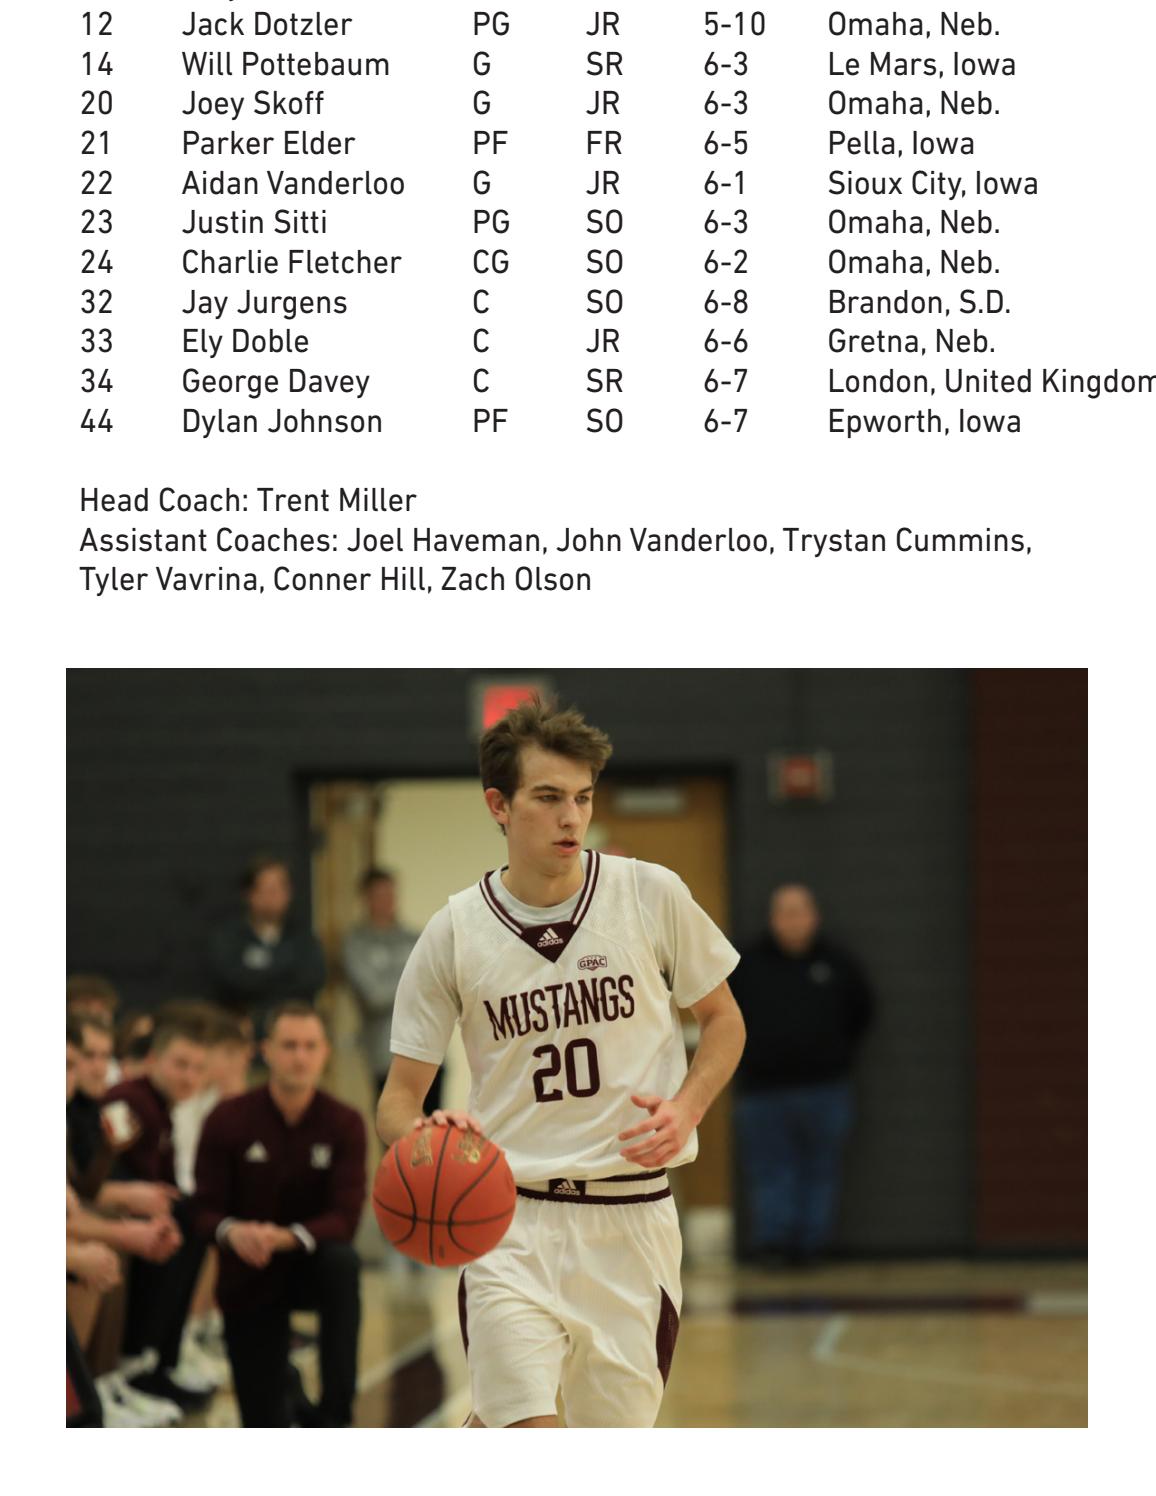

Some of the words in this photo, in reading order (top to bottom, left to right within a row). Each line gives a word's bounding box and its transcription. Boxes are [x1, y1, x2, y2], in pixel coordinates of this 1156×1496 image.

[82, 51, 114, 76] 14
[181, 51, 233, 76] Will
[242, 51, 389, 76] Pottebaum
[473, 51, 491, 76] G
[586, 51, 623, 76] SR
[704, 50, 748, 76] 6-3
[829, 51, 860, 76] Le
[870, 51, 944, 79] Mars,
[954, 51, 1016, 76] Iowa
[81, 129, 108, 155] 21
[183, 130, 275, 155] Parker
[284, 130, 356, 155] Elder
[474, 130, 508, 155] PF
[587, 130, 622, 155] FR
[704, 130, 748, 155] 6-5
[829, 130, 903, 158] Pella,
[913, 130, 974, 155] Iowa
[81, 169, 113, 195] 22
[181, 170, 258, 195] Aidan
[266, 170, 405, 195] Vanderloo
[473, 169, 491, 195] G
[585, 170, 620, 195] JR
[704, 170, 744, 195] 6-1
[828, 169, 903, 195] Sioux
[911, 169, 966, 201] City,
[976, 170, 1038, 195] Iowa
[81, 248, 114, 274] 24
[182, 248, 279, 274] Charlie
[289, 249, 402, 274] Fletcher
[473, 248, 509, 274] CG
[586, 248, 623, 274] SO
[704, 248, 748, 274] 6-2
[828, 248, 931, 277] Omaha,
[941, 249, 1000, 274] Neb.
[80, 327, 113, 353] 33
[183, 328, 223, 359] Ely
[232, 328, 309, 353] Doble
[473, 327, 490, 353] C
[585, 328, 620, 353] JR
[704, 328, 748, 353] 6-6
[828, 327, 926, 356] Gretna,
[936, 328, 995, 353] Neb.
[80, 368, 114, 393] 34
[182, 367, 279, 400] George
[289, 368, 370, 399] Davey
[473, 367, 490, 393] C
[586, 367, 623, 393] SR
[704, 368, 748, 393] 6-7
[829, 368, 936, 396] London,
[945, 368, 1032, 393] United
[80, 408, 114, 433] 44
[183, 408, 258, 439] Dylan
[267, 408, 382, 433] Johnson
[474, 408, 508, 433] PF
[586, 407, 623, 433] SO
[704, 408, 748, 433] 6-7
[829, 408, 949, 439] Epworth,
[959, 408, 1021, 433] Iowa
[81, 487, 149, 512] Head
[159, 486, 248, 512] Coach:
[256, 487, 330, 512] Trent
[339, 487, 417, 512] Miller
[79, 527, 207, 552] Assistant
[216, 526, 338, 552] Coaches:
[346, 527, 404, 552] Joel
[413, 527, 548, 555] Haveman,
[556, 527, 621, 552] John
[629, 527, 775, 555] Vanderloo,
[782, 527, 886, 558] Trystan
[896, 526, 1032, 555] Cummins,
[79, 566, 149, 597] Tyler
[155, 566, 265, 594] Vavrina,
[274, 566, 372, 591] Conner
[381, 566, 432, 594] Hill,
[441, 566, 505, 591] Zach
[515, 565, 591, 591] Olson
[537, 937, 564, 948] adidas
[482, 974, 636, 1041] MUSTANGS
[532, 1037, 601, 1103] 20
